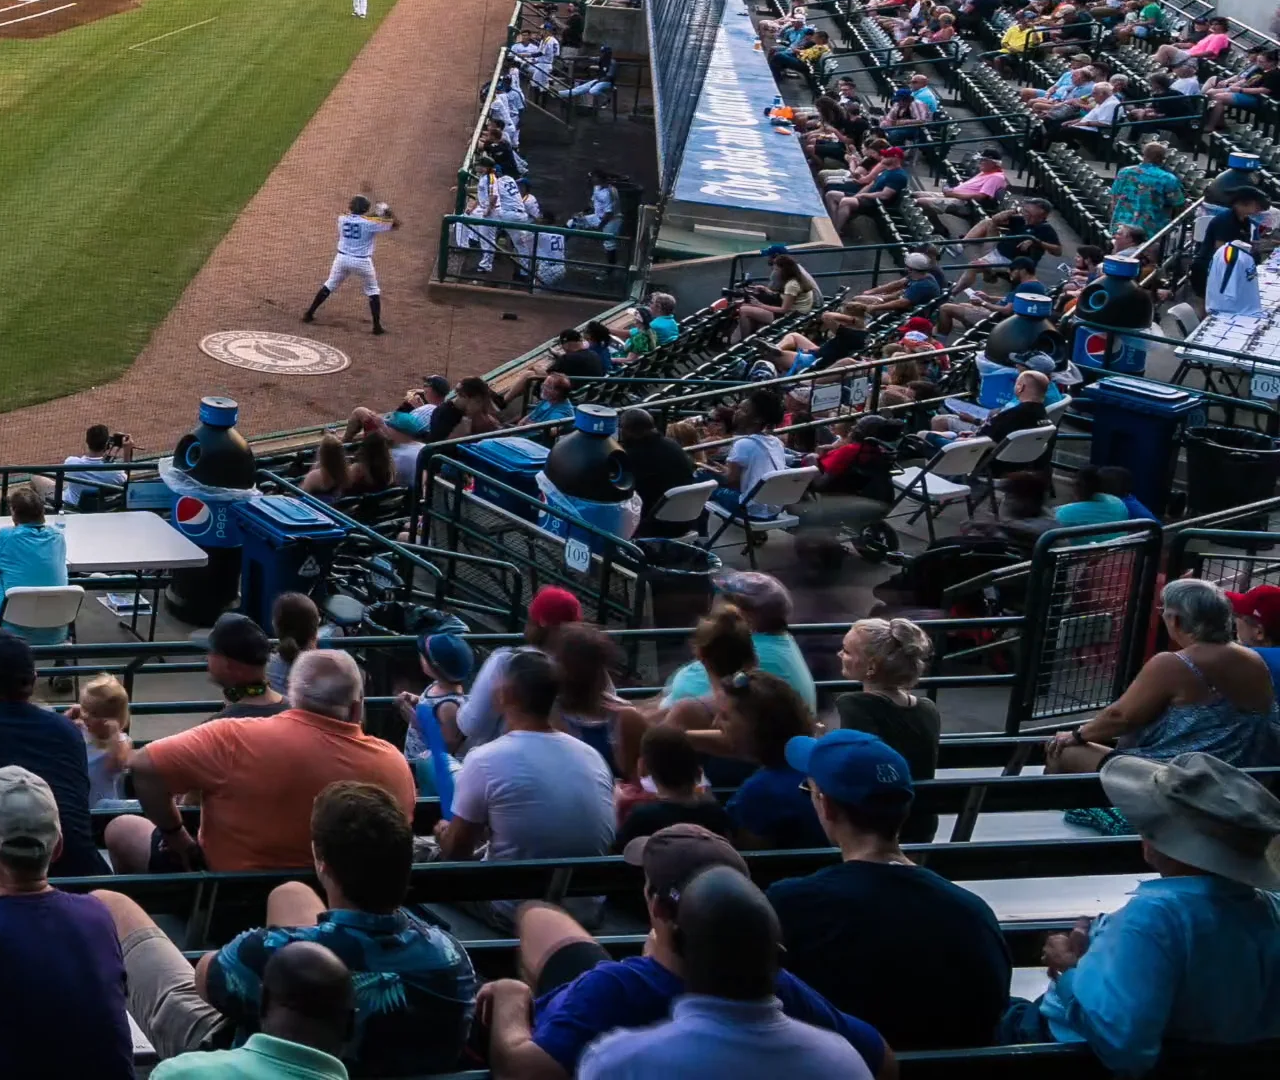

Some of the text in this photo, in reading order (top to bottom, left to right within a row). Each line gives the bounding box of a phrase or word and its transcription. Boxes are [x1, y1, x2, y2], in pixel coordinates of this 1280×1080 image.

[1253, 379, 1280, 395] 108
[215, 503, 228, 539] pepsi
[566, 545, 589, 566] 109
